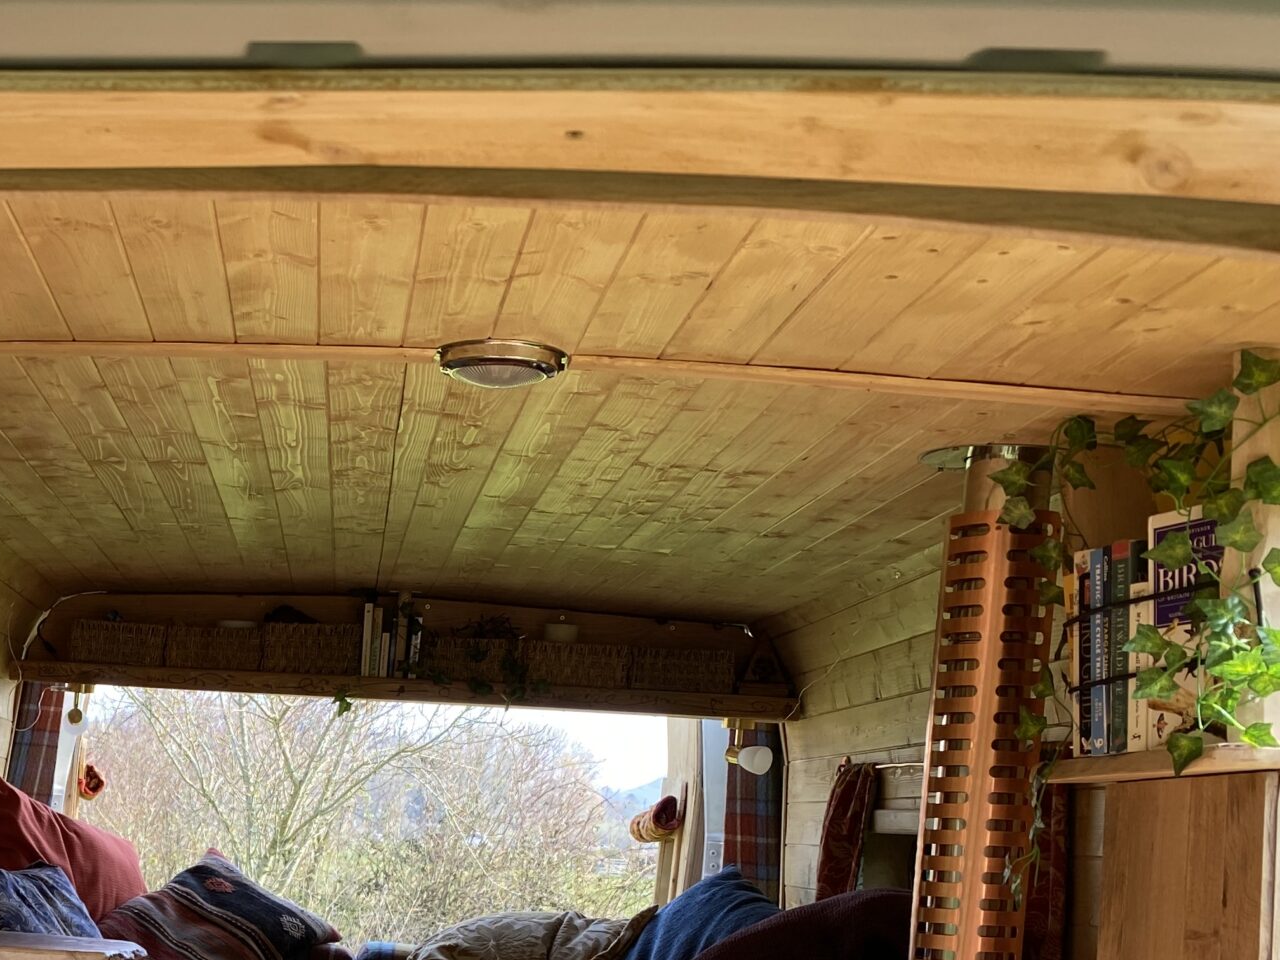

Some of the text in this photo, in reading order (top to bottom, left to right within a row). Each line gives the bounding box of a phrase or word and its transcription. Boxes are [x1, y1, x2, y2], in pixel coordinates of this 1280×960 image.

[1193, 534, 1216, 549] GUI
[1117, 563, 1125, 627] BRITSH
[1158, 559, 1222, 593] BIR
[1081, 613, 1091, 658] IRD
[1115, 630, 1124, 696] WILDLFE
